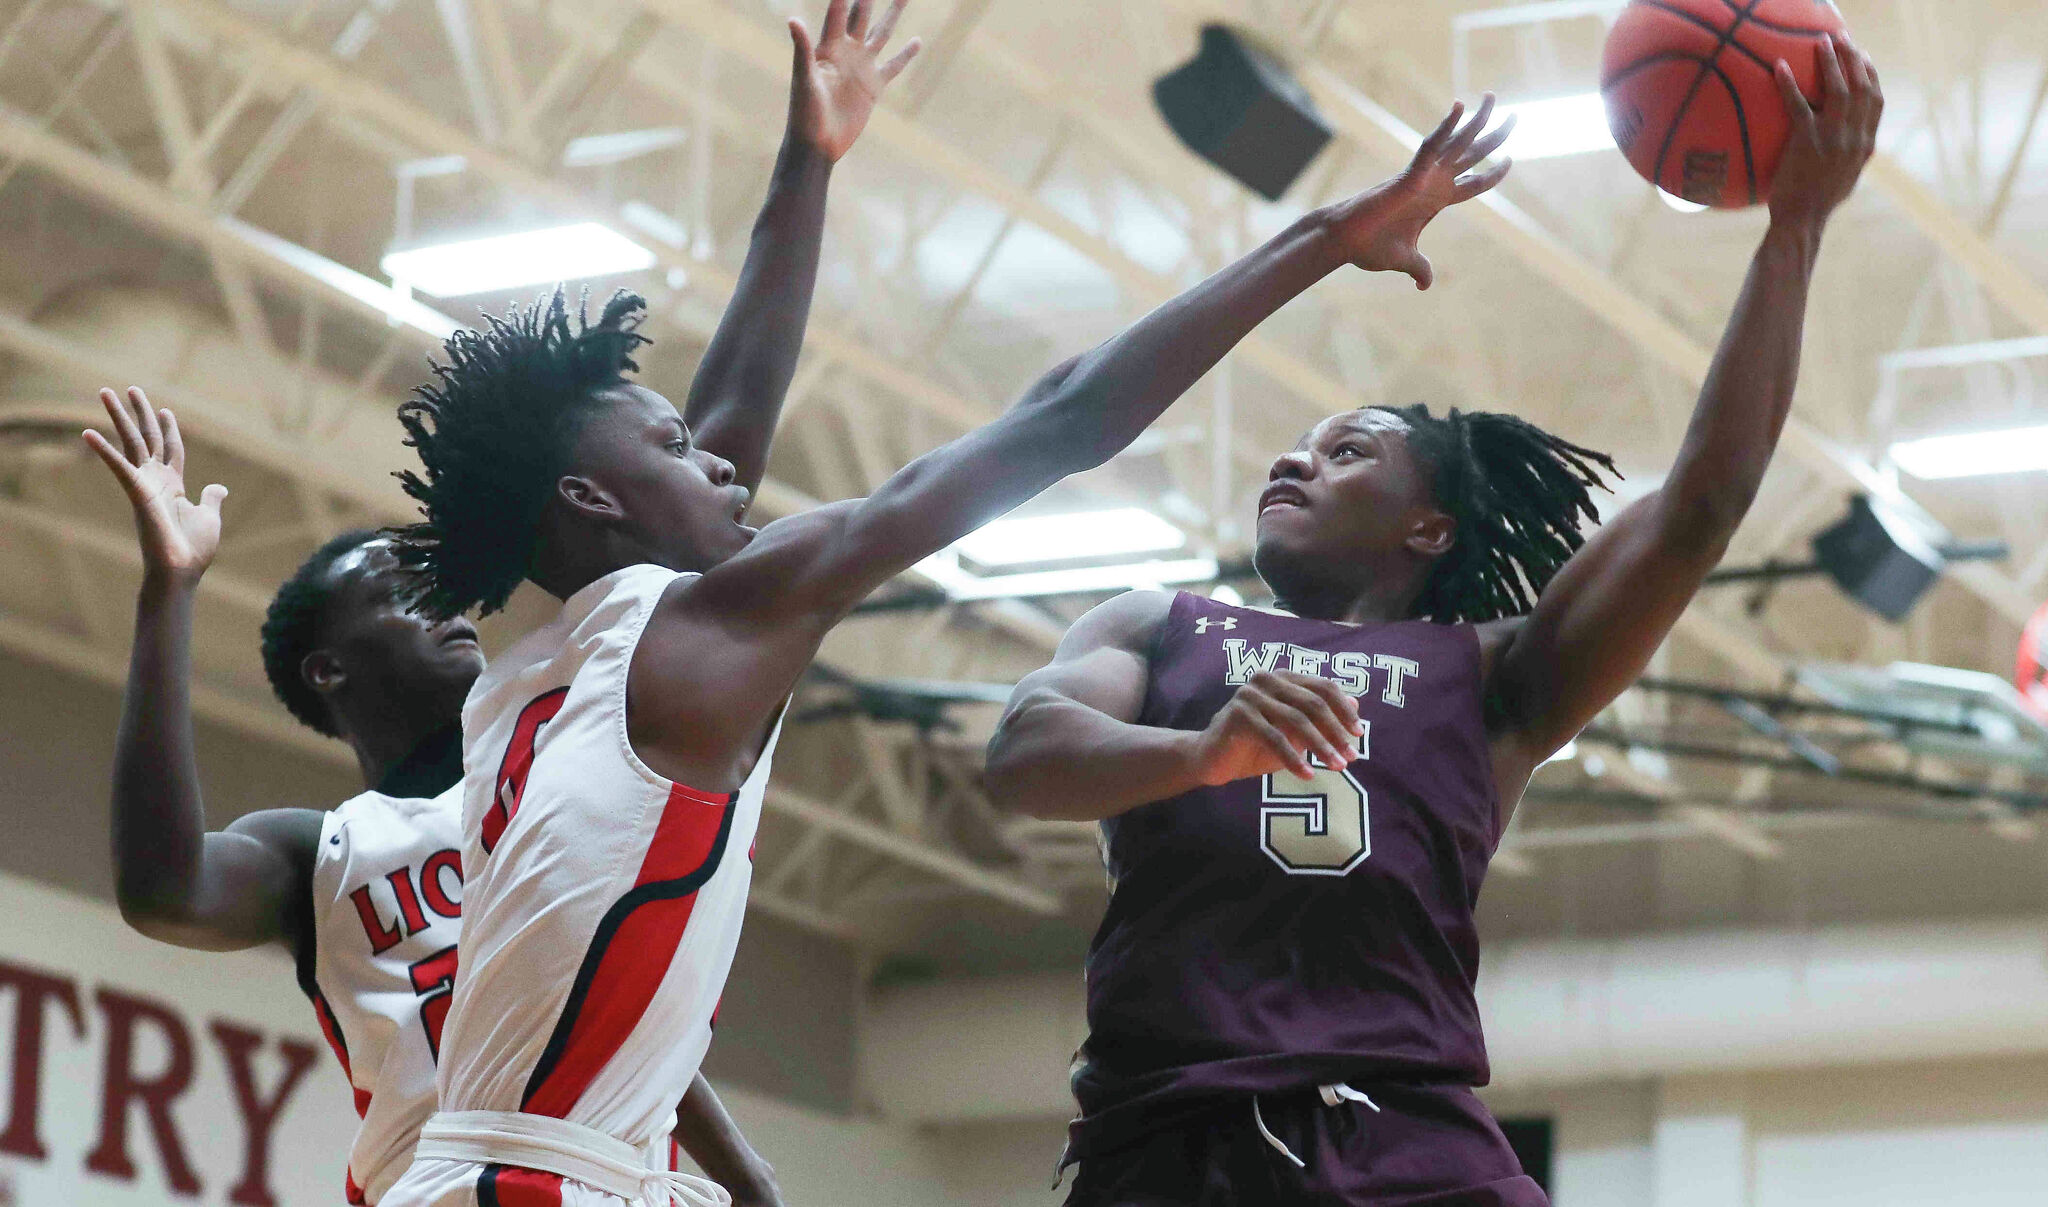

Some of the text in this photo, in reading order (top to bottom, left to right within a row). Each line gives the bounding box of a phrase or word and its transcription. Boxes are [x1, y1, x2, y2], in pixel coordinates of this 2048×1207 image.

[1222, 638, 1419, 708] WEST
[1259, 718, 1371, 876] 5
[0, 958, 320, 1207] TRY
